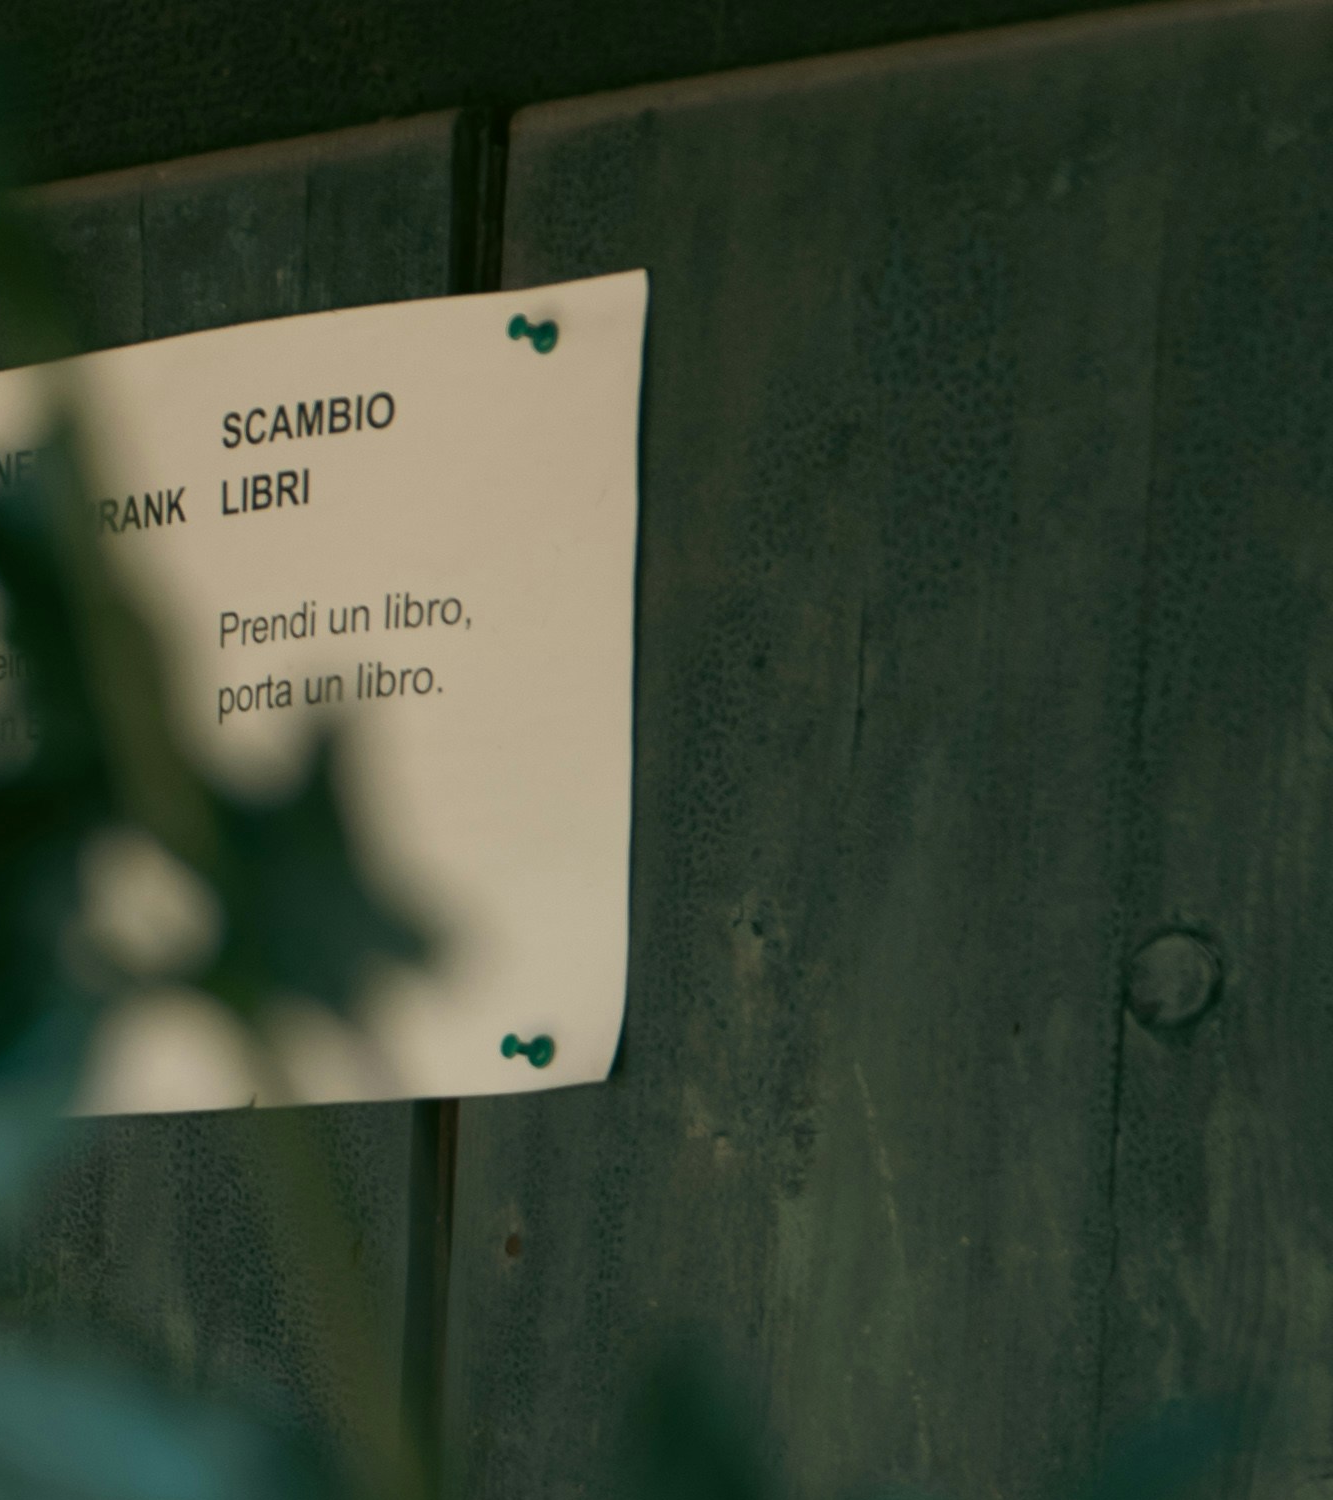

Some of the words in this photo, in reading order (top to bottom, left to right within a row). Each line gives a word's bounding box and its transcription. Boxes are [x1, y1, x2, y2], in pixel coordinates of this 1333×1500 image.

[222, 391, 395, 449] SCAMBIO
[221, 468, 310, 516] LIBRI
[219, 600, 317, 649] Prendi
[329, 604, 370, 635] un
[385, 591, 472, 630] libro,
[218, 673, 293, 725] porta
[304, 673, 344, 705] un
[357, 661, 443, 701] libro.
